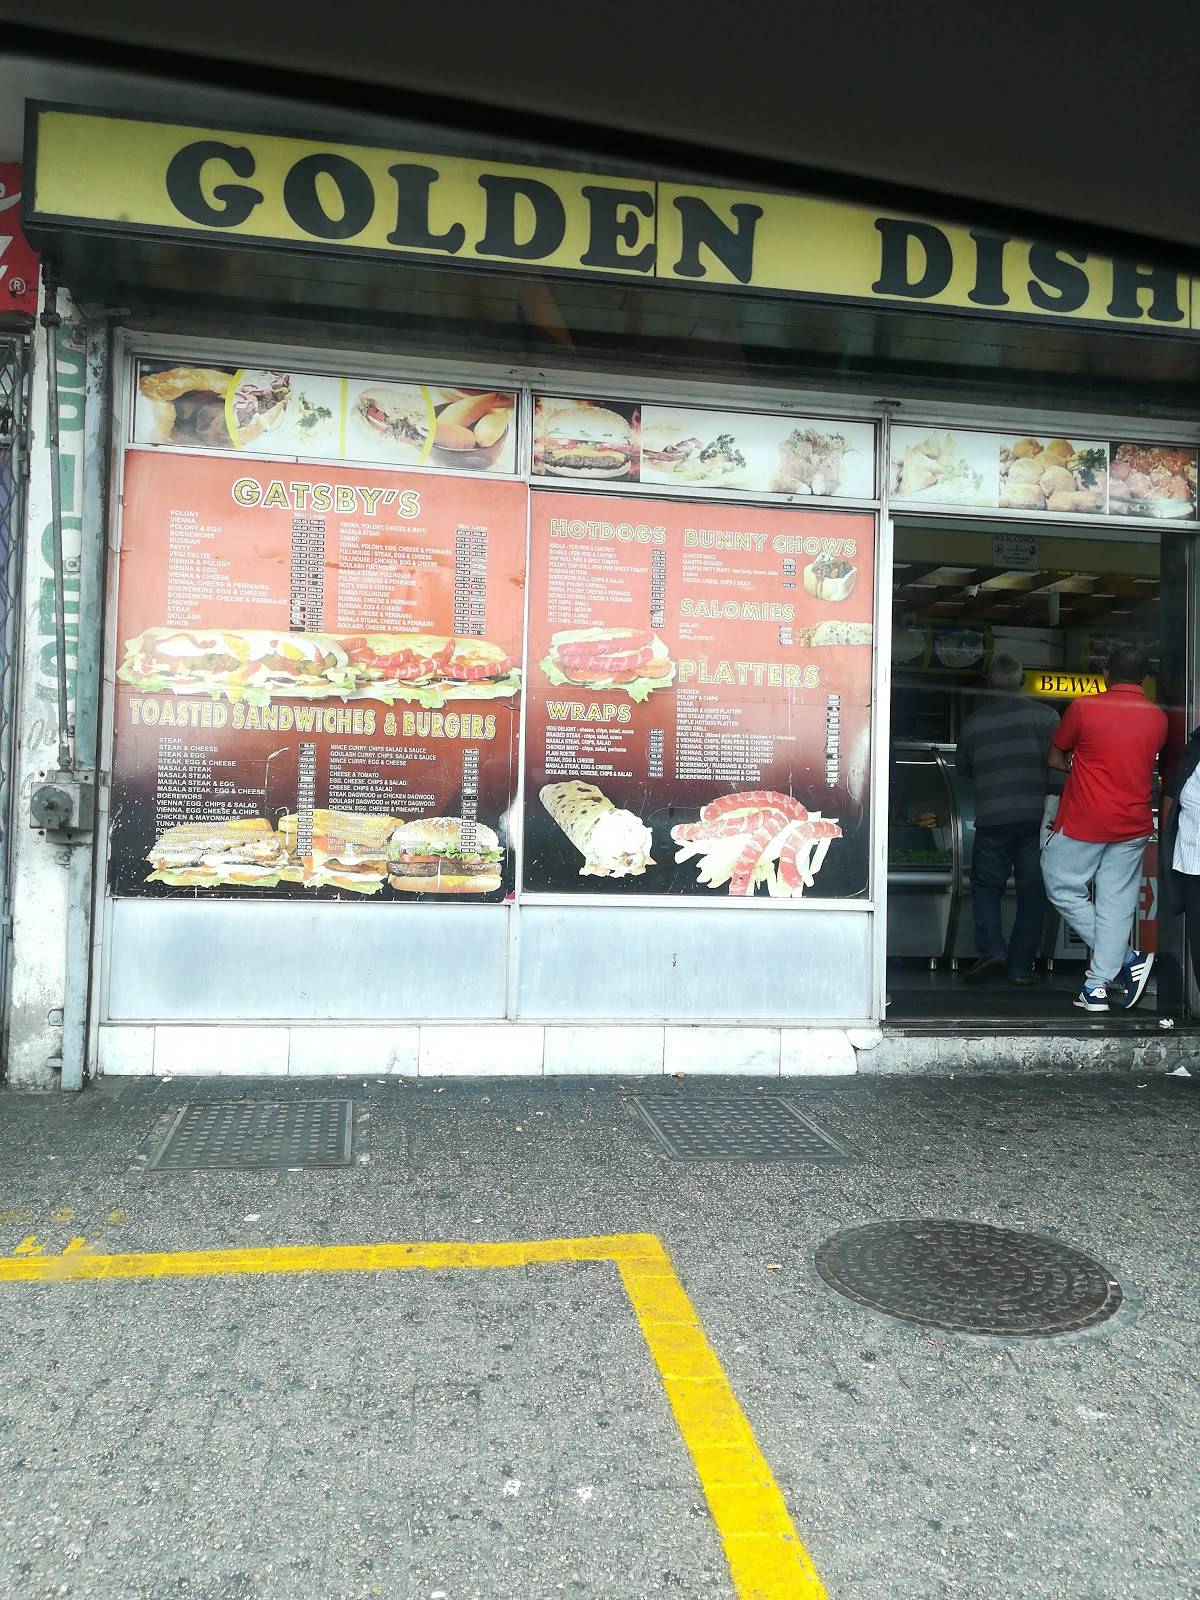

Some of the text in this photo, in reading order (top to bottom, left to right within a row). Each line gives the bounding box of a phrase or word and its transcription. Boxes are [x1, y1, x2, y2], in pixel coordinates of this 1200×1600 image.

[166, 141, 1184, 322] GOLDEN DISH
[232, 478, 421, 519] GATSBY'S
[551, 518, 666, 544] HOTDOGS
[684, 528, 857, 558] BUNNY CHOWS
[680, 598, 795, 622] SALOMIES
[678, 659, 820, 688] PLATTERS
[130, 699, 496, 739] TOASTED SANDWICHES & BURGERS
[546, 701, 632, 722] WRAPS
